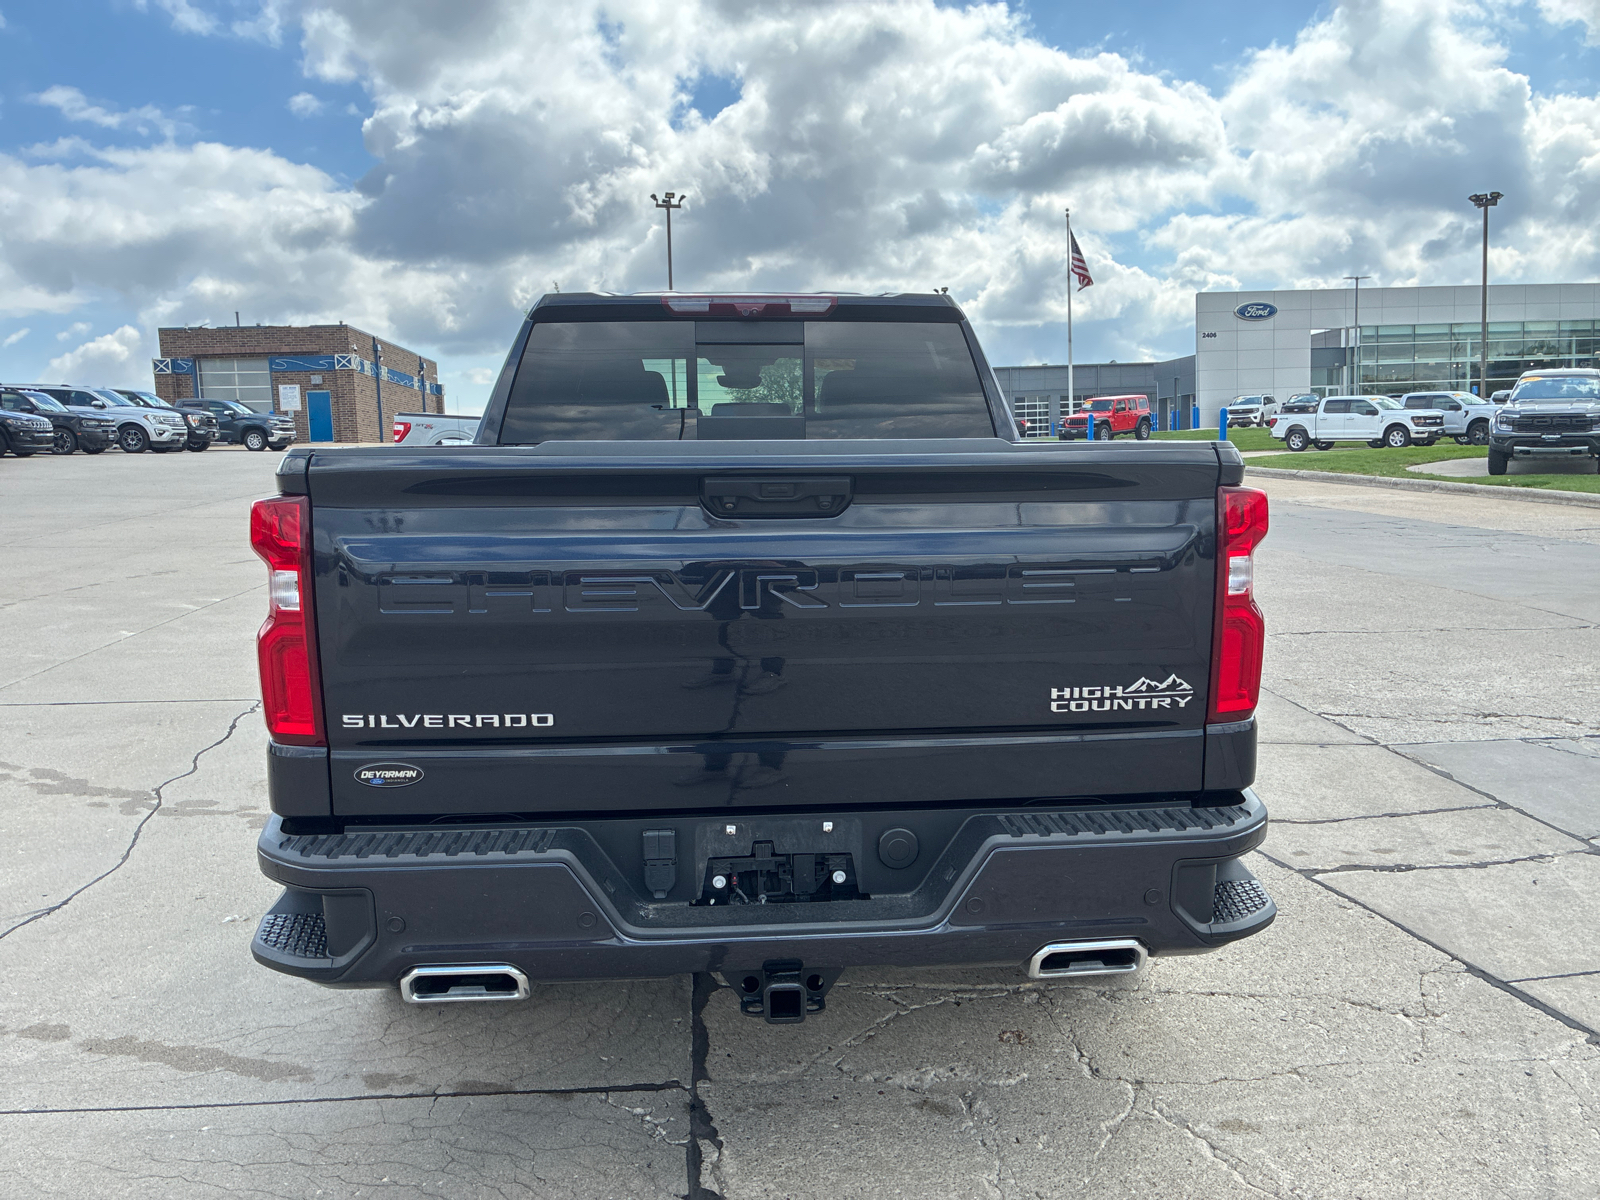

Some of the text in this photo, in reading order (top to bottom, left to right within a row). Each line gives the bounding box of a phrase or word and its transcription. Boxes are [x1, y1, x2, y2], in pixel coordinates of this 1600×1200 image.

[1245, 305, 1270, 317] Ford
[378, 564, 1162, 613] CHEVROLET
[1051, 686, 1123, 699] HIGH
[1051, 696, 1193, 712] COUNTRY
[342, 713, 554, 728] SILVERADO
